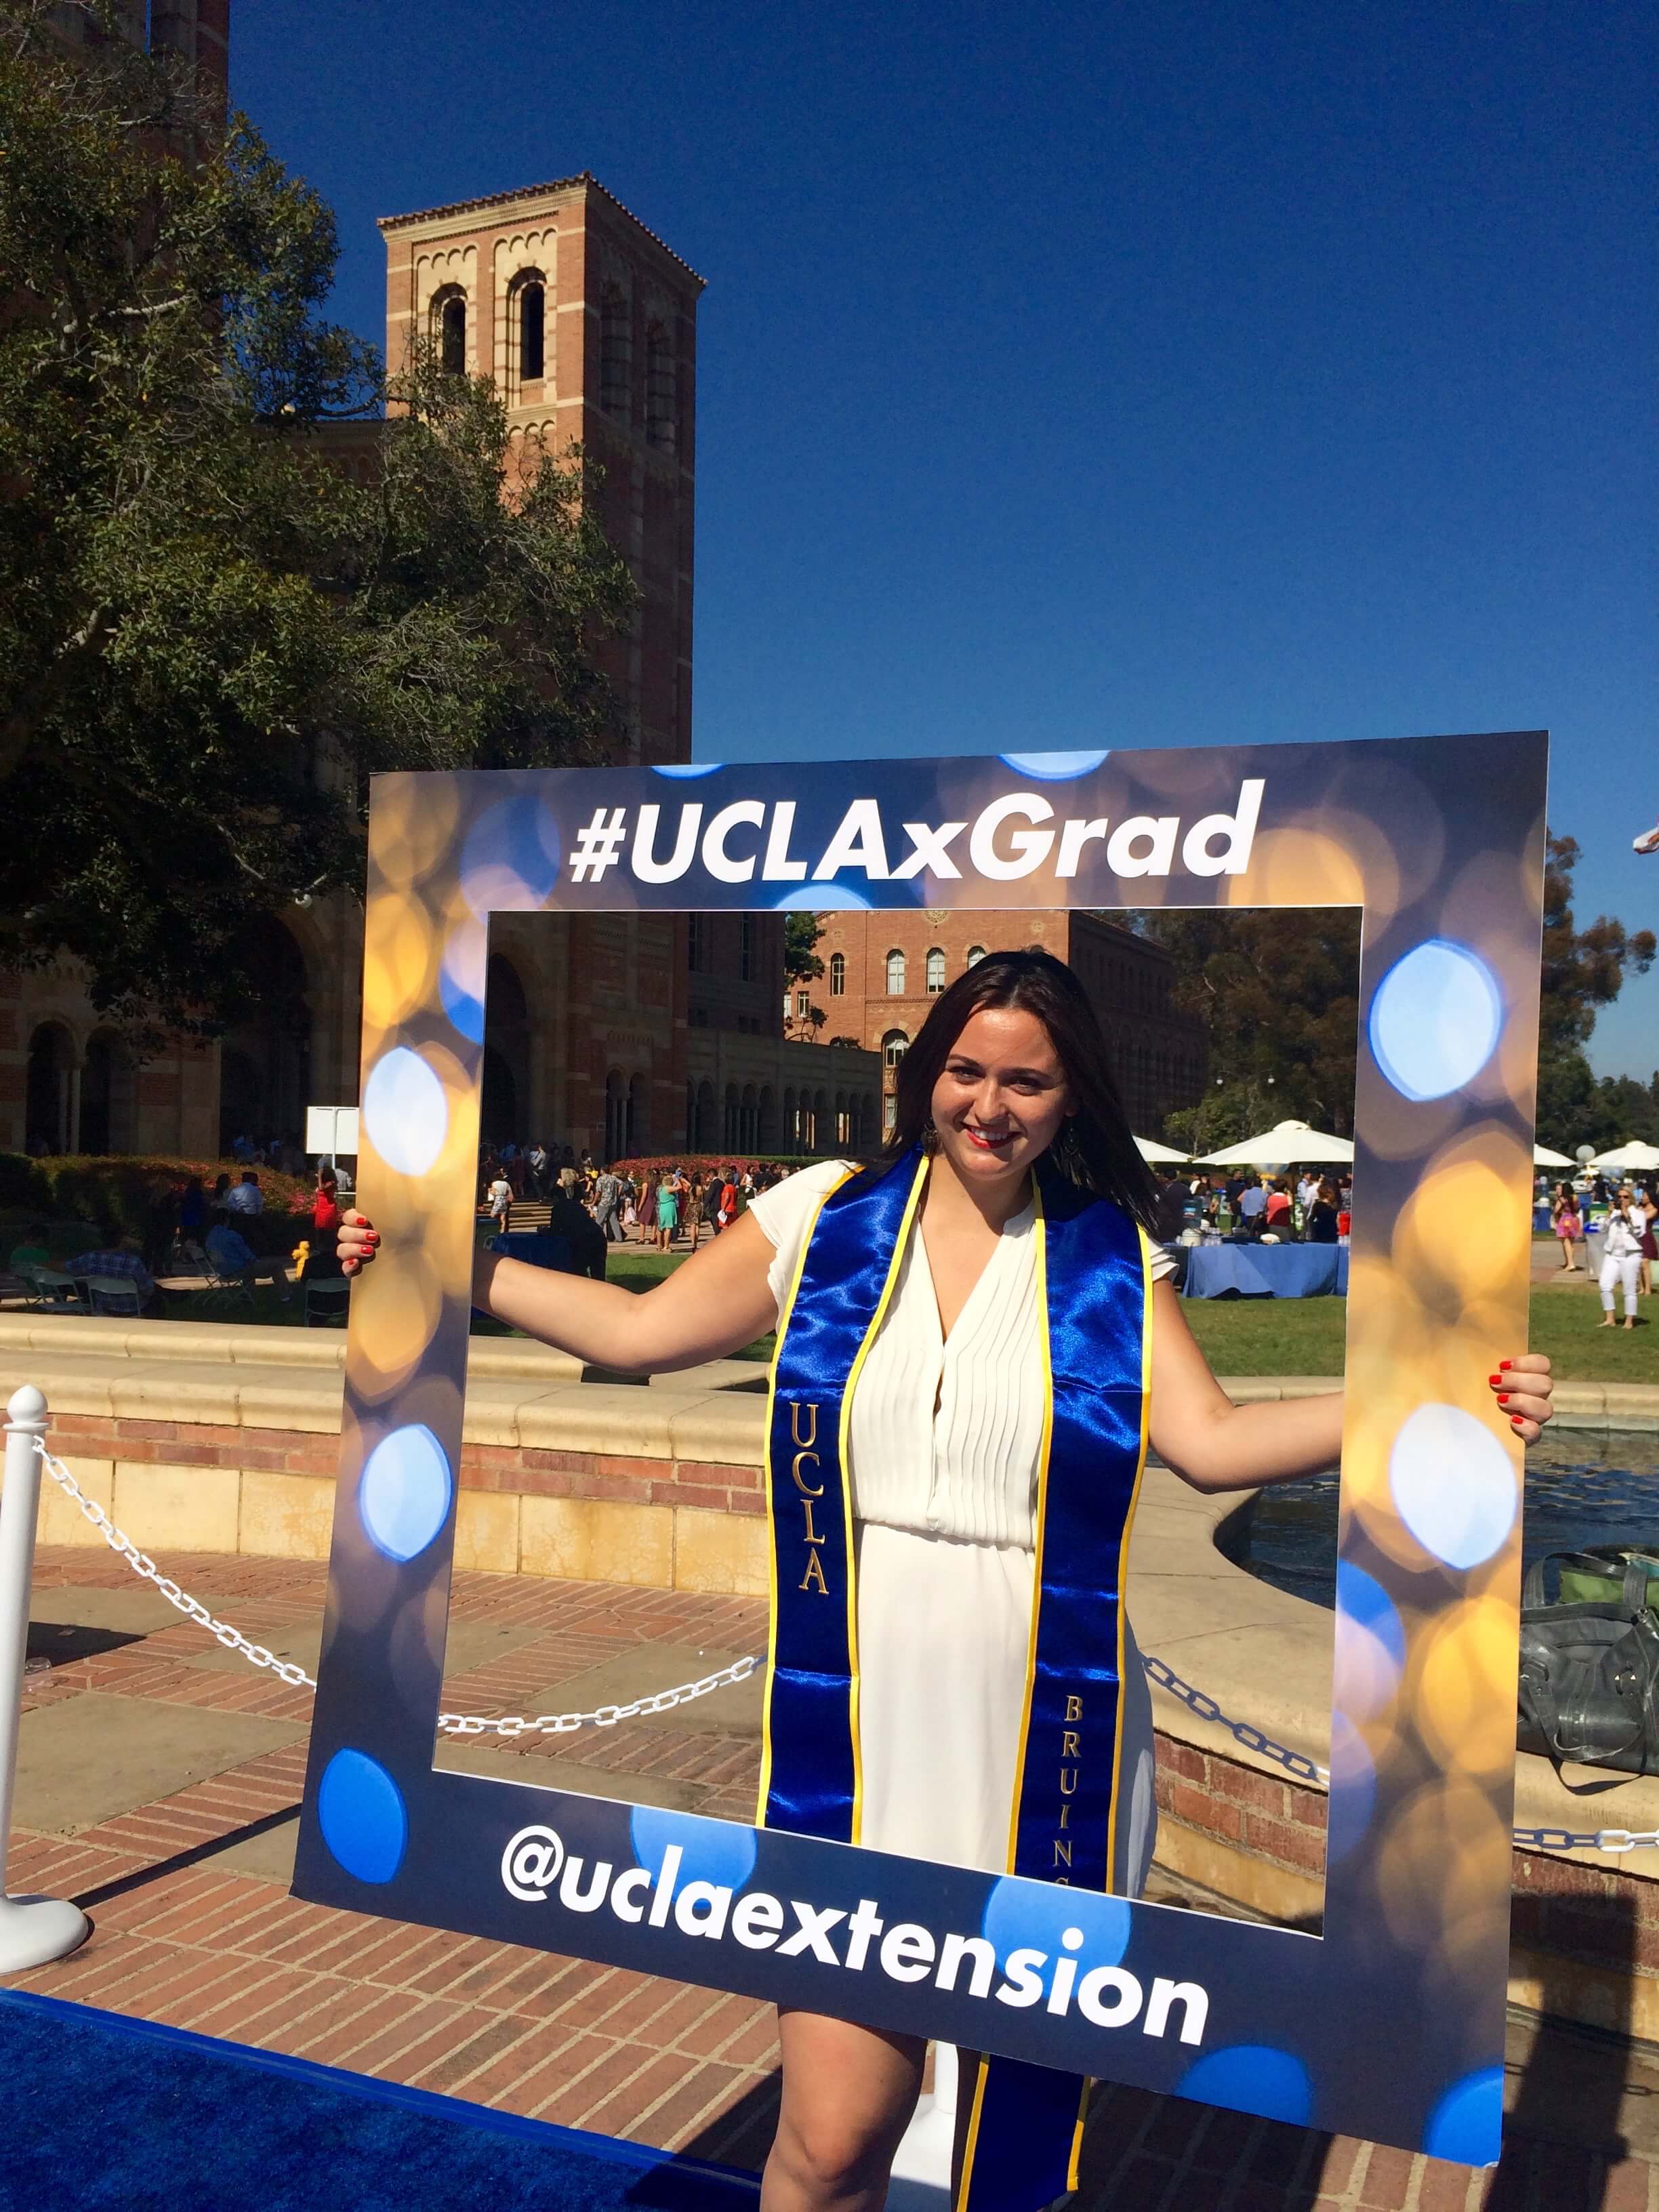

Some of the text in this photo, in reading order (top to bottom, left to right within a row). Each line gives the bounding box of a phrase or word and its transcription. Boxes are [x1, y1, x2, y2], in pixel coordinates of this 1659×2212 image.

[569, 778, 1266, 884] #UCLAxGrad
[790, 1400, 830, 1595] UCLA
[501, 1824, 1210, 2045] @uclaextension
